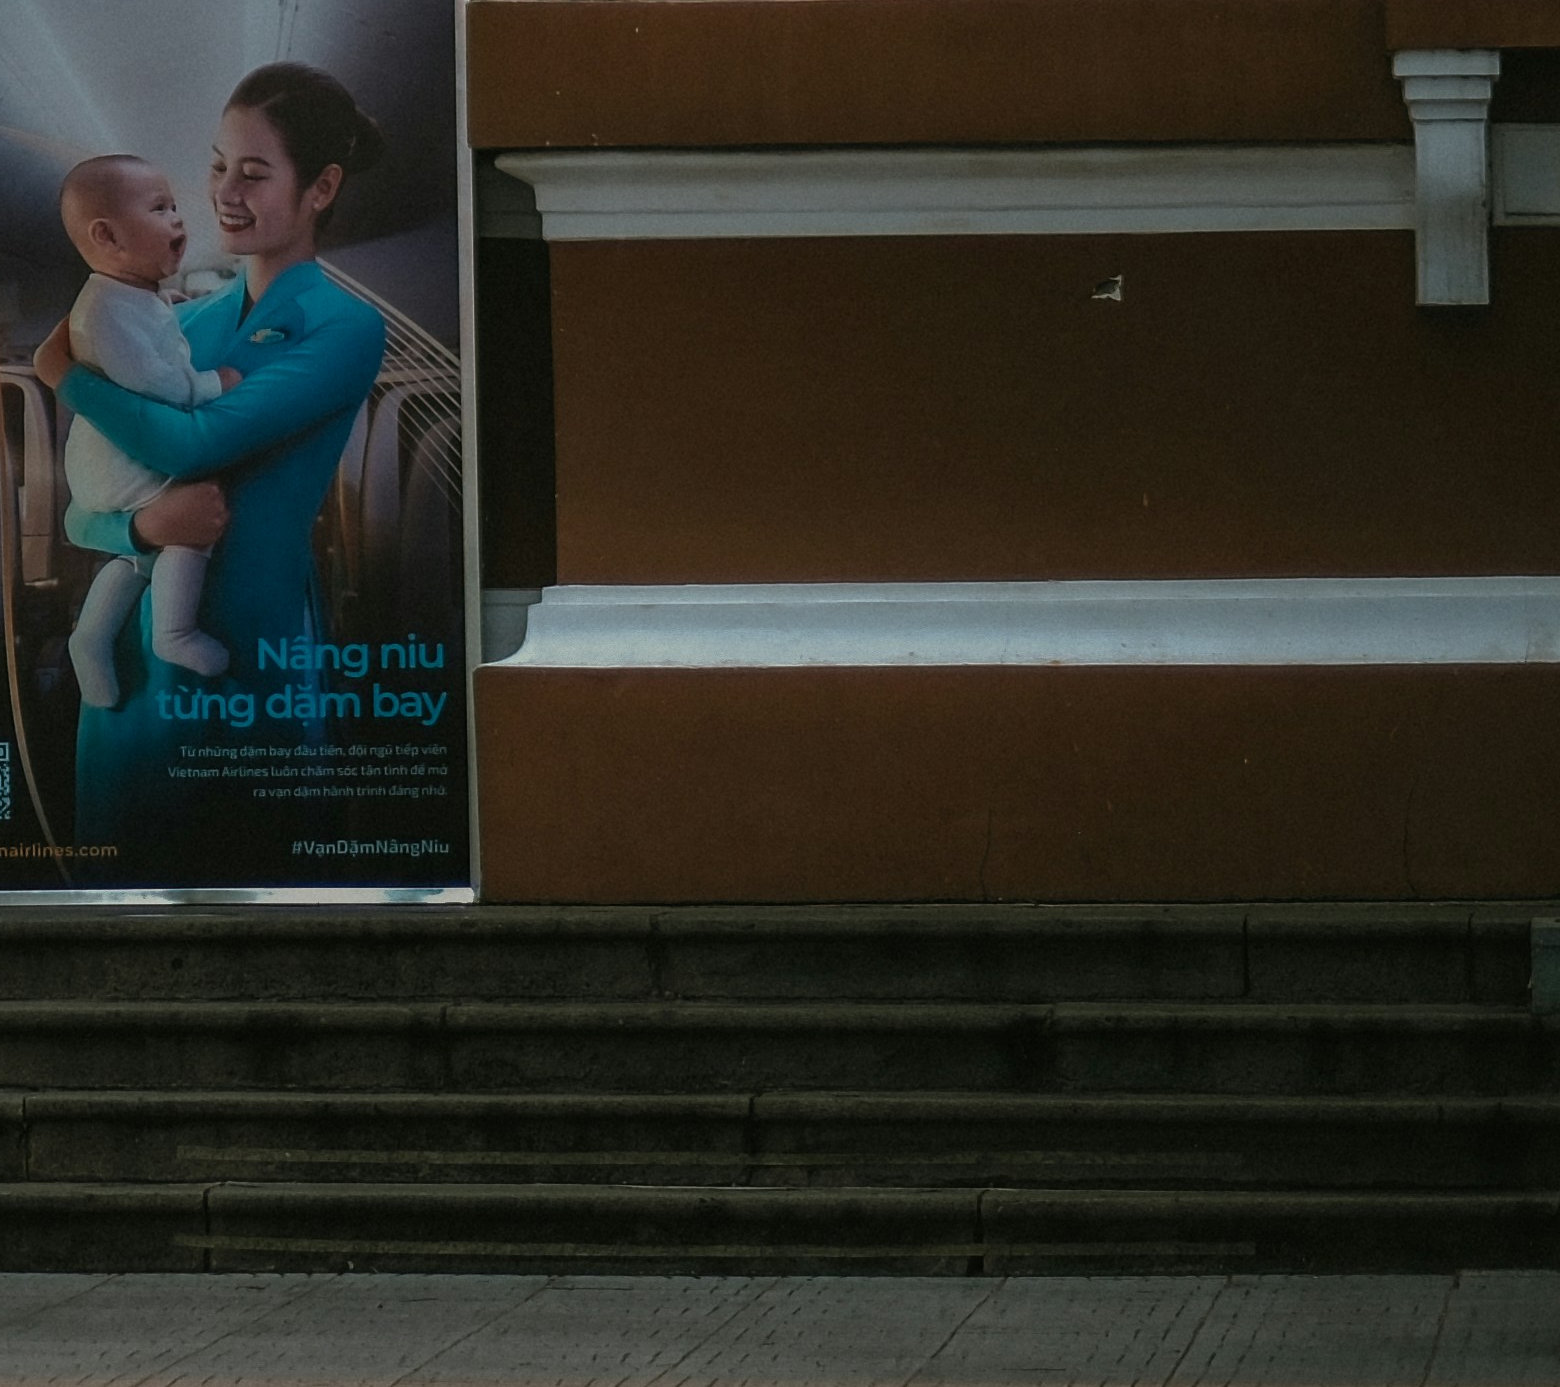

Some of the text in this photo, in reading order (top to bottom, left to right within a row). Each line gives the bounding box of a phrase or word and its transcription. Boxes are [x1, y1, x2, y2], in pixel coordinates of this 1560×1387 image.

[257, 633, 445, 678] Nâng niu
[155, 682, 448, 728] từng dặm bay
[269, 745, 291, 759] bay
[421, 742, 448, 756] viên
[167, 766, 219, 778] Vietnam
[221, 766, 269, 778] Airlines
[270, 765, 299, 778] luôn
[253, 788, 267, 798] ra
[291, 839, 450, 858] #VạnDặmNângNiu
